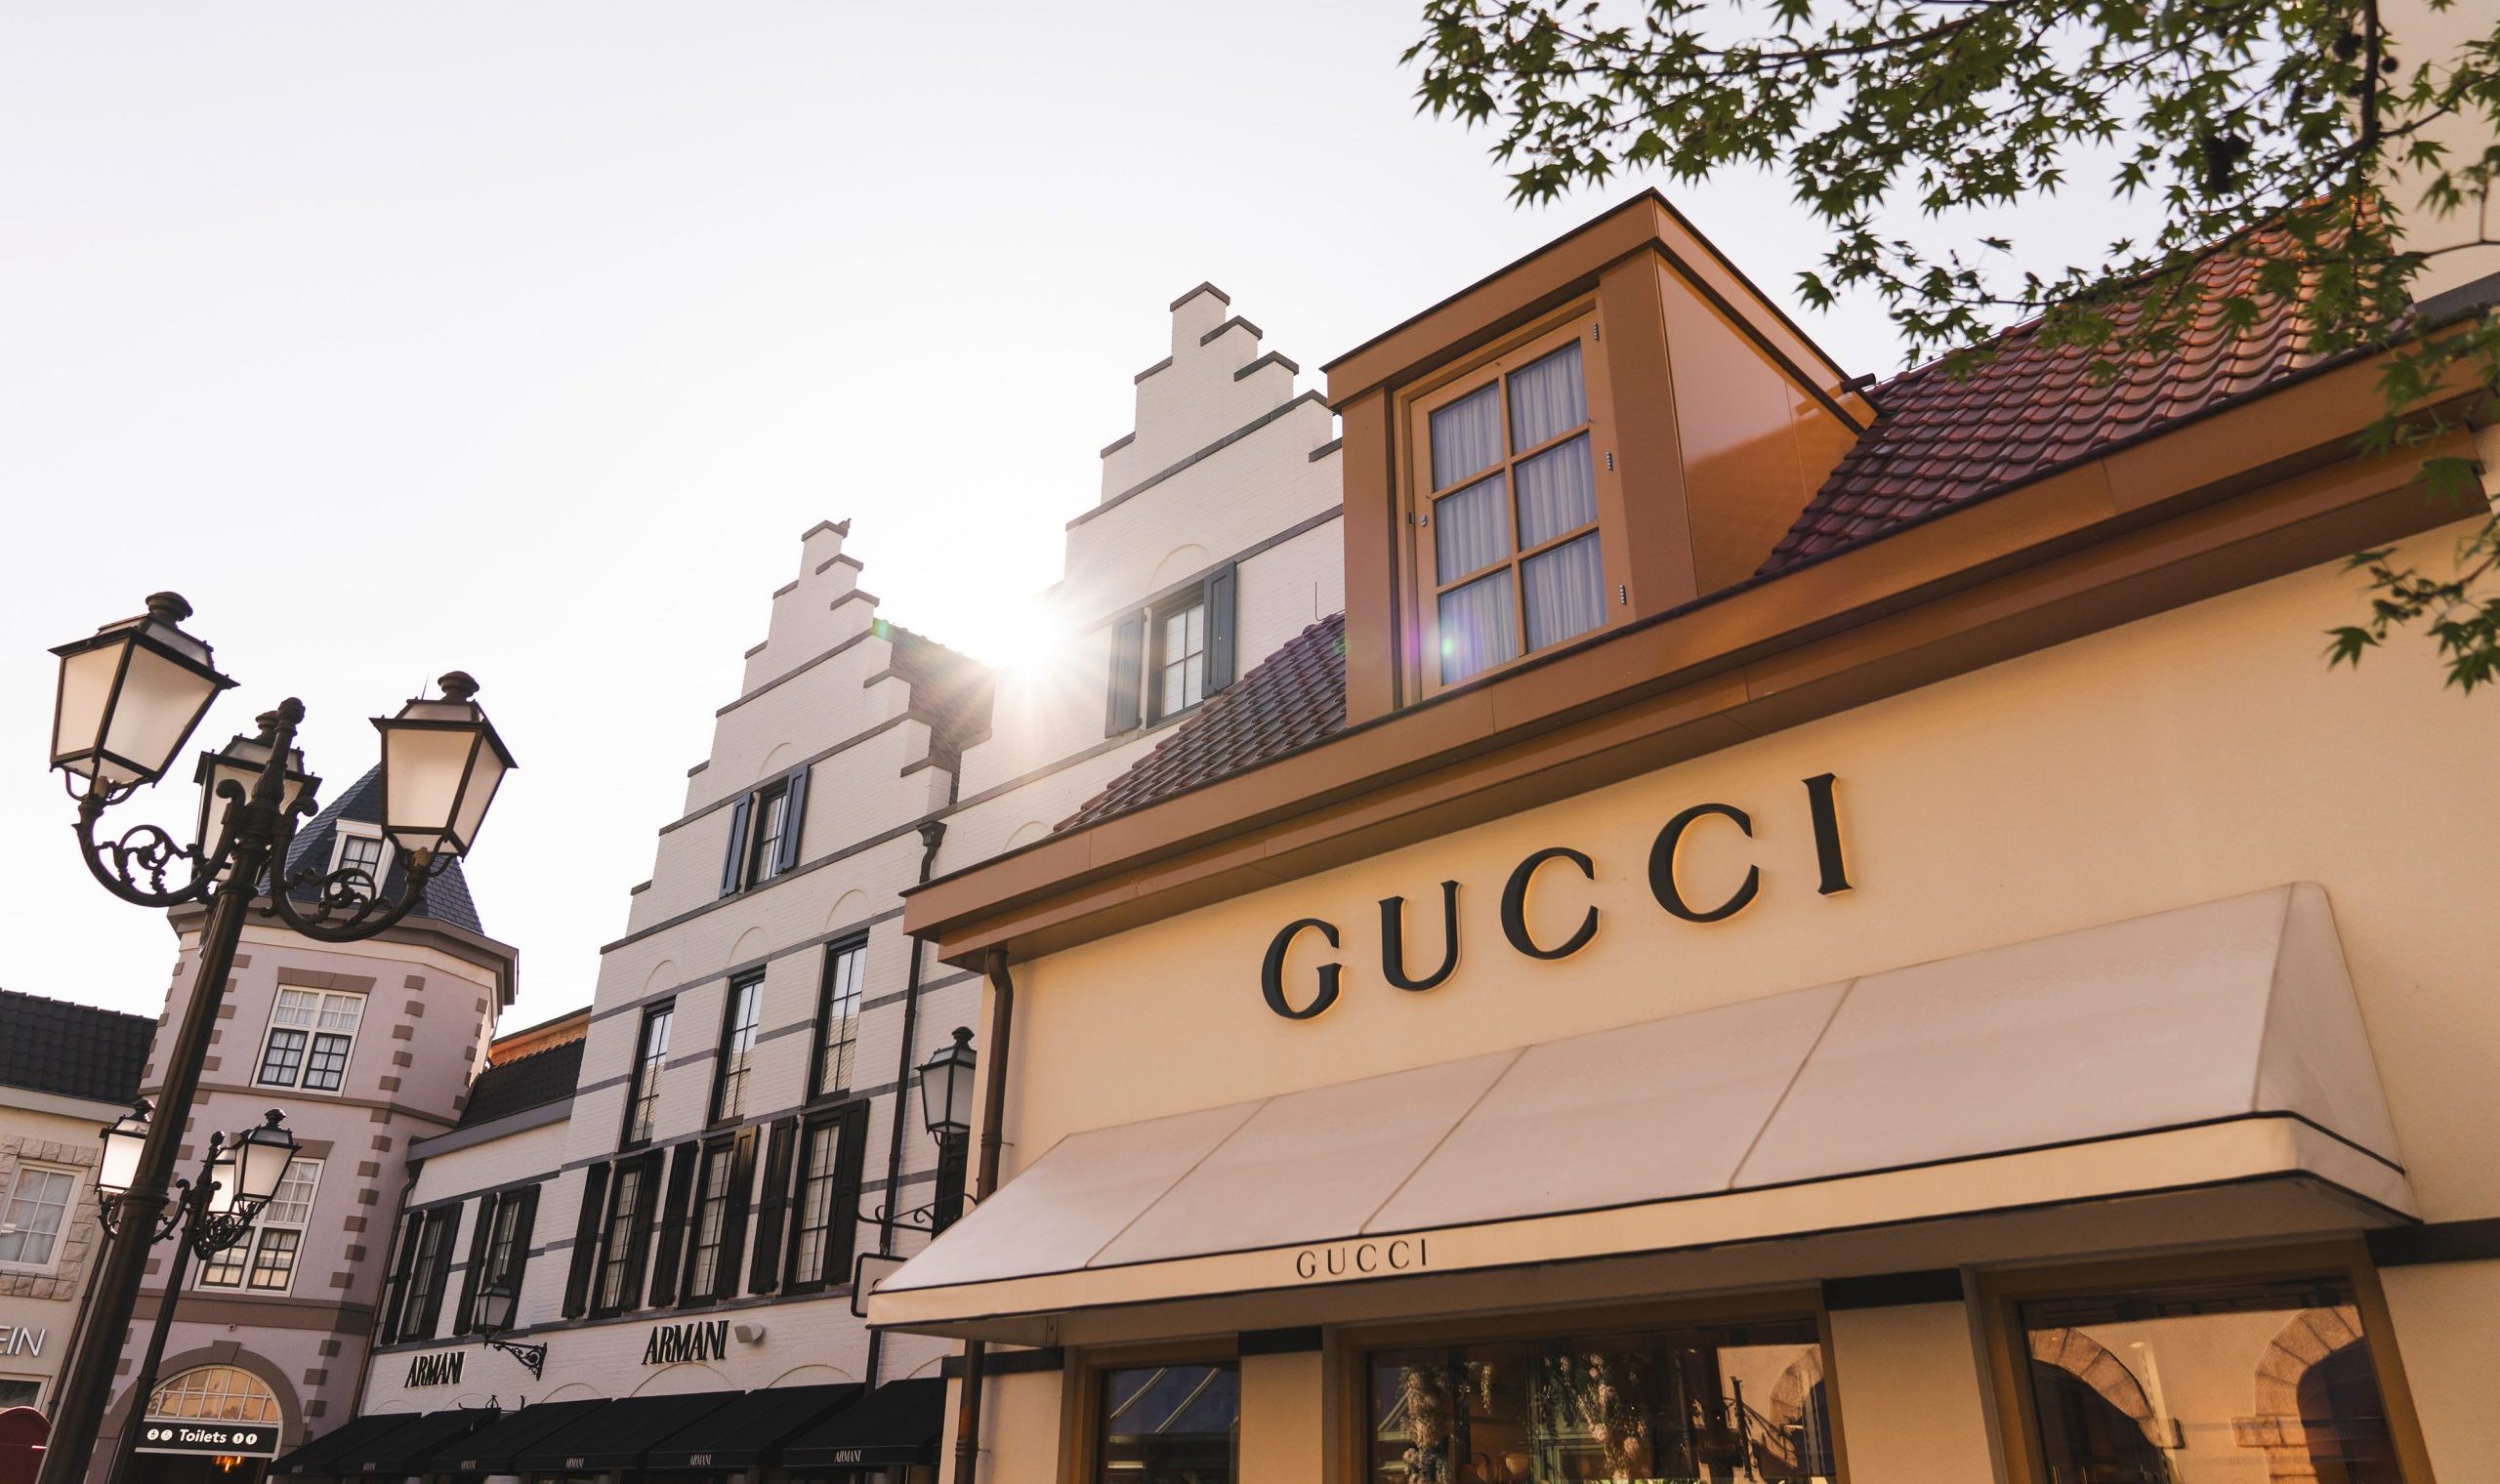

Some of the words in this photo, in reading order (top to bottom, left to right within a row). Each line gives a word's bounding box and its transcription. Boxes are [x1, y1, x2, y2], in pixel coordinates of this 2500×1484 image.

[1261, 772, 1854, 1020] GUCCI
[1296, 1238, 1427, 1279] GUCCI
[642, 1320, 729, 1365] ARMANI
[403, 1351, 466, 1387] ARMANI
[180, 1428, 227, 1443] Toilets
[834, 1450, 861, 1463] ARMANI
